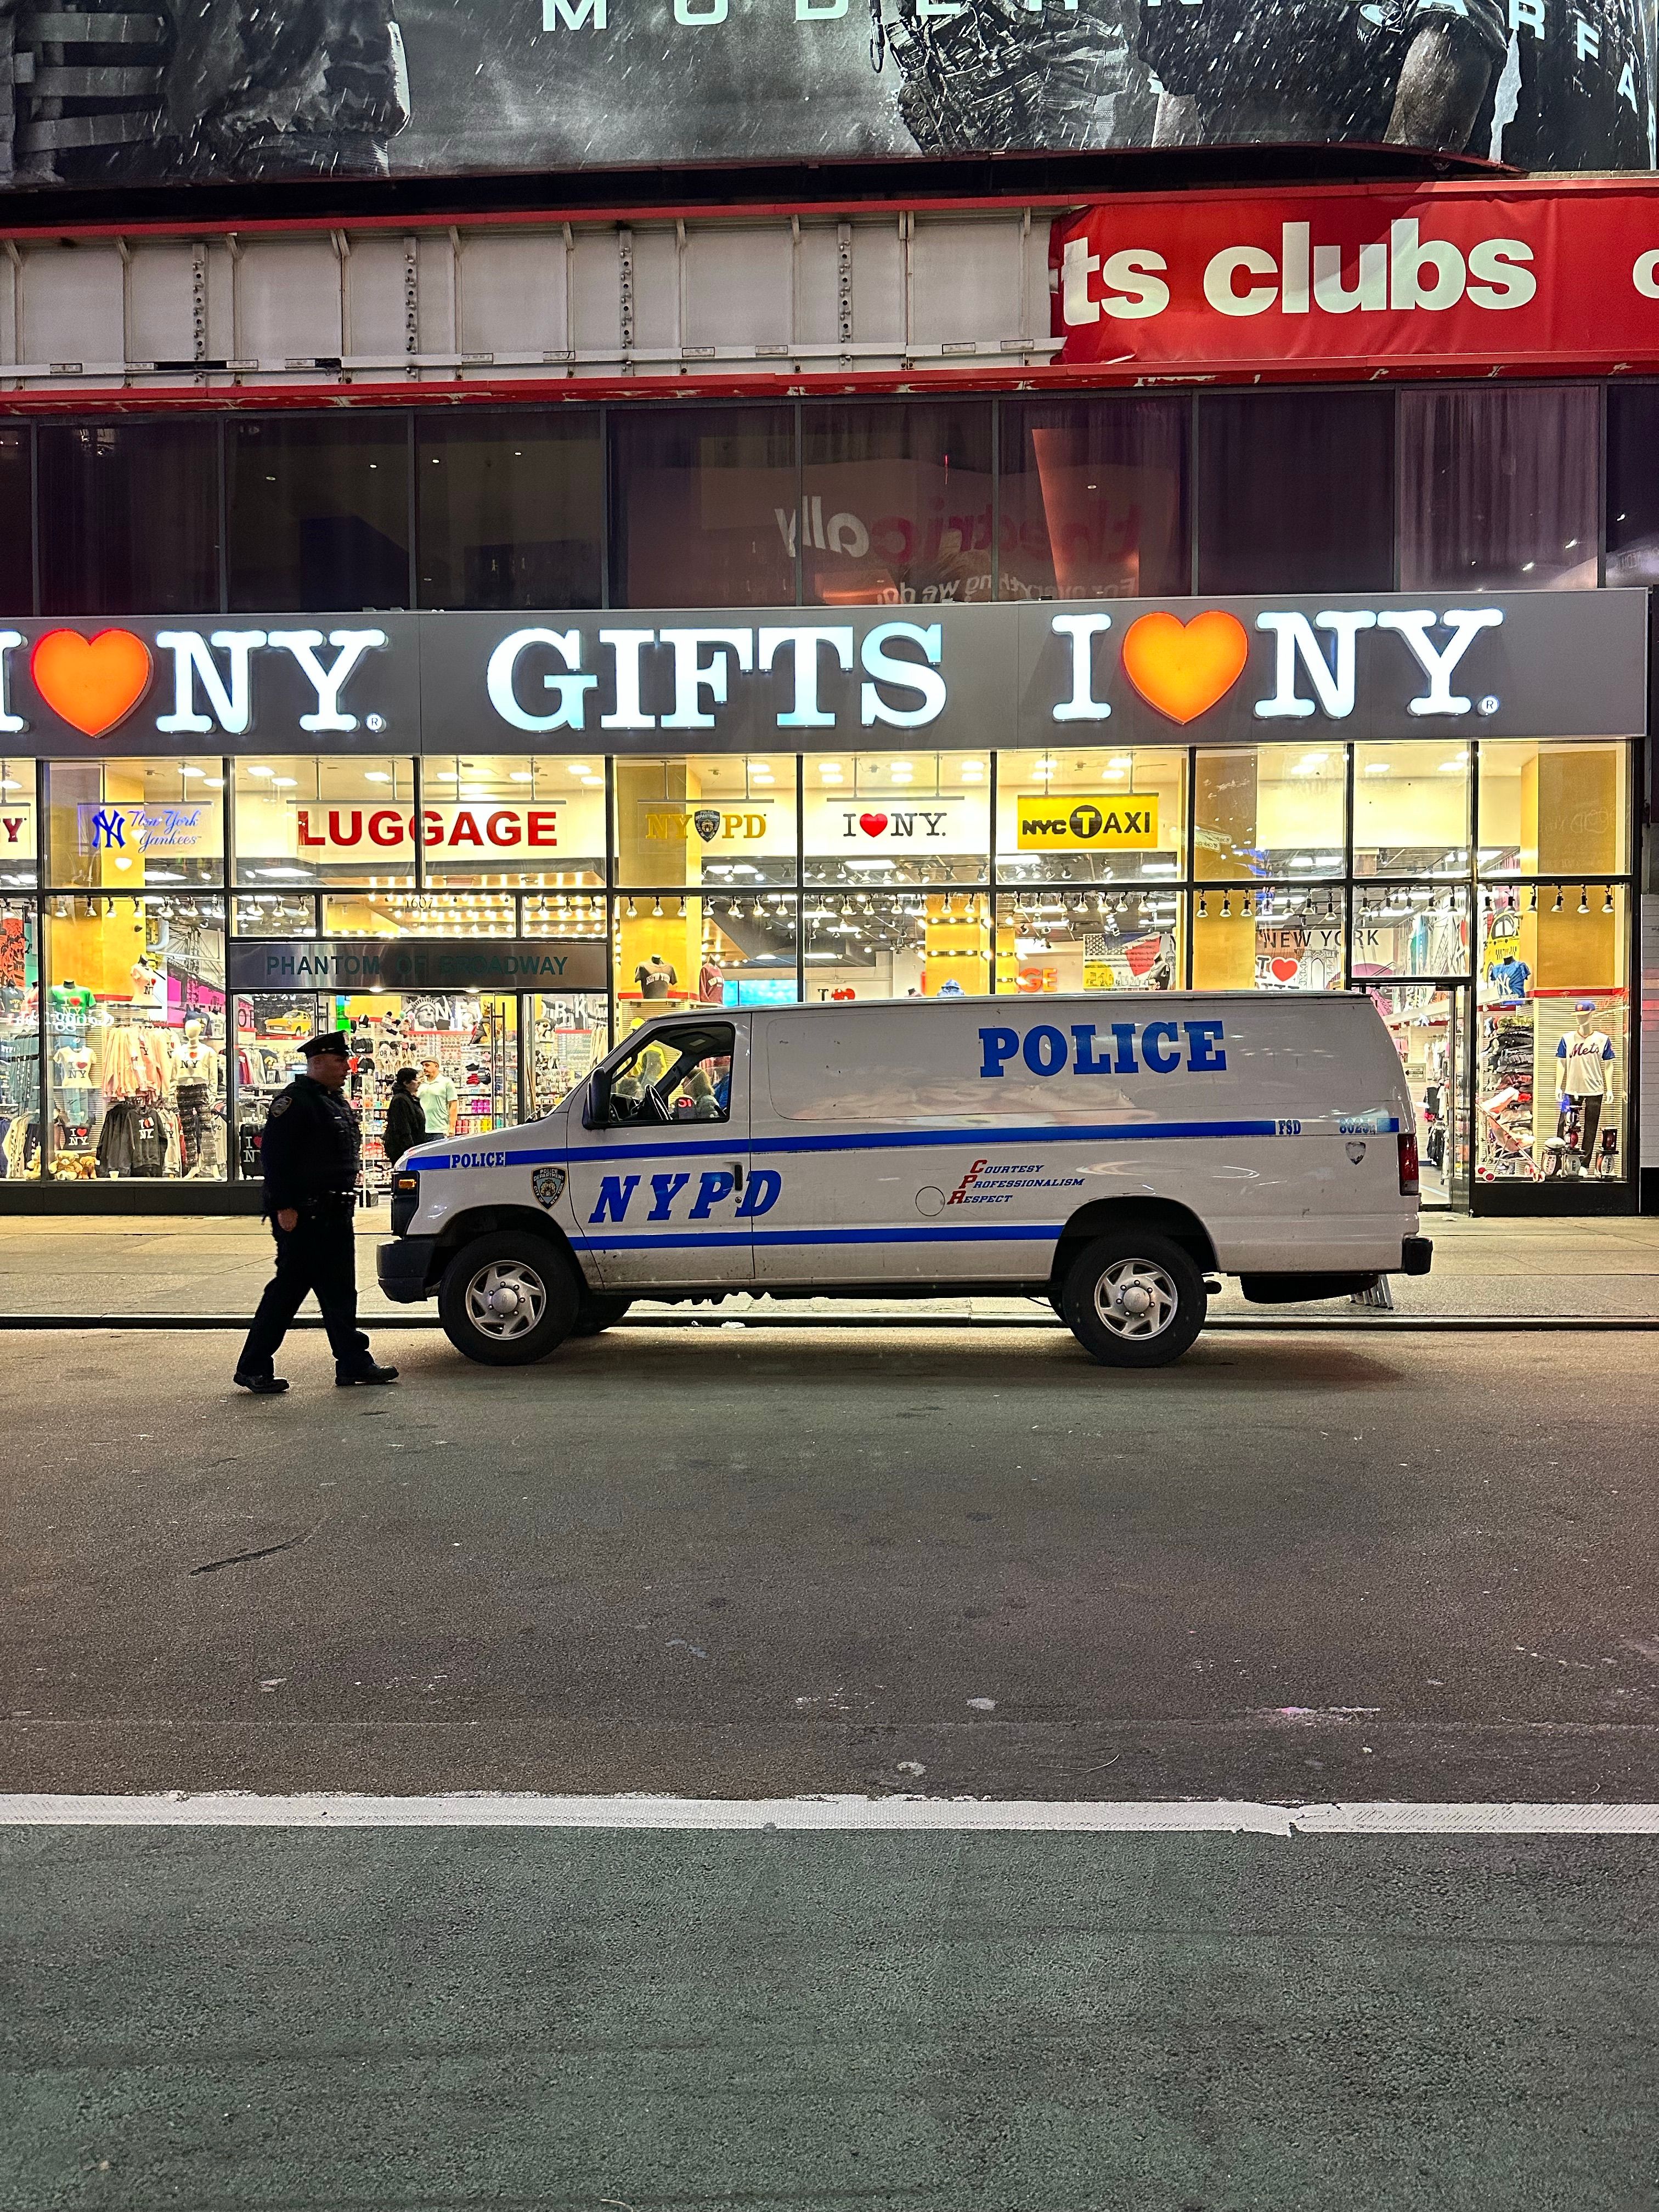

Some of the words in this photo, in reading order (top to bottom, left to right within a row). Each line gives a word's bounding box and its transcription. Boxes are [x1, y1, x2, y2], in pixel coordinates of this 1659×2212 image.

[1204, 217, 1536, 315] clubs
[1051, 613, 1113, 722] I
[487, 622, 947, 733] GIFTS
[163, 809, 201, 834] York
[297, 810, 557, 847] LUGGAGE
[843, 814, 856, 837] I
[1022, 820, 1066, 835] NYC
[1073, 808, 1150, 836] TAXI
[407, 897, 433, 909] 1607
[1263, 930, 1312, 949] NEW
[267, 955, 379, 975] PHANTOM
[396, 956, 426, 975] OF
[440, 956, 568, 975] BROADWAY
[978, 1020, 1227, 1077] POLICE
[1570, 1042, 1599, 1058] Mets
[180, 1060, 200, 1069] NY
[67, 1070, 87, 1079] NY
[70, 1128, 76, 1137] I
[1278, 1120, 1301, 1135] FSD
[68, 1136, 89, 1146] NY
[452, 1152, 504, 1169] POLICE
[533, 1173, 564, 1182] DEPARTMENT
[588, 1170, 782, 1223] NYPD
